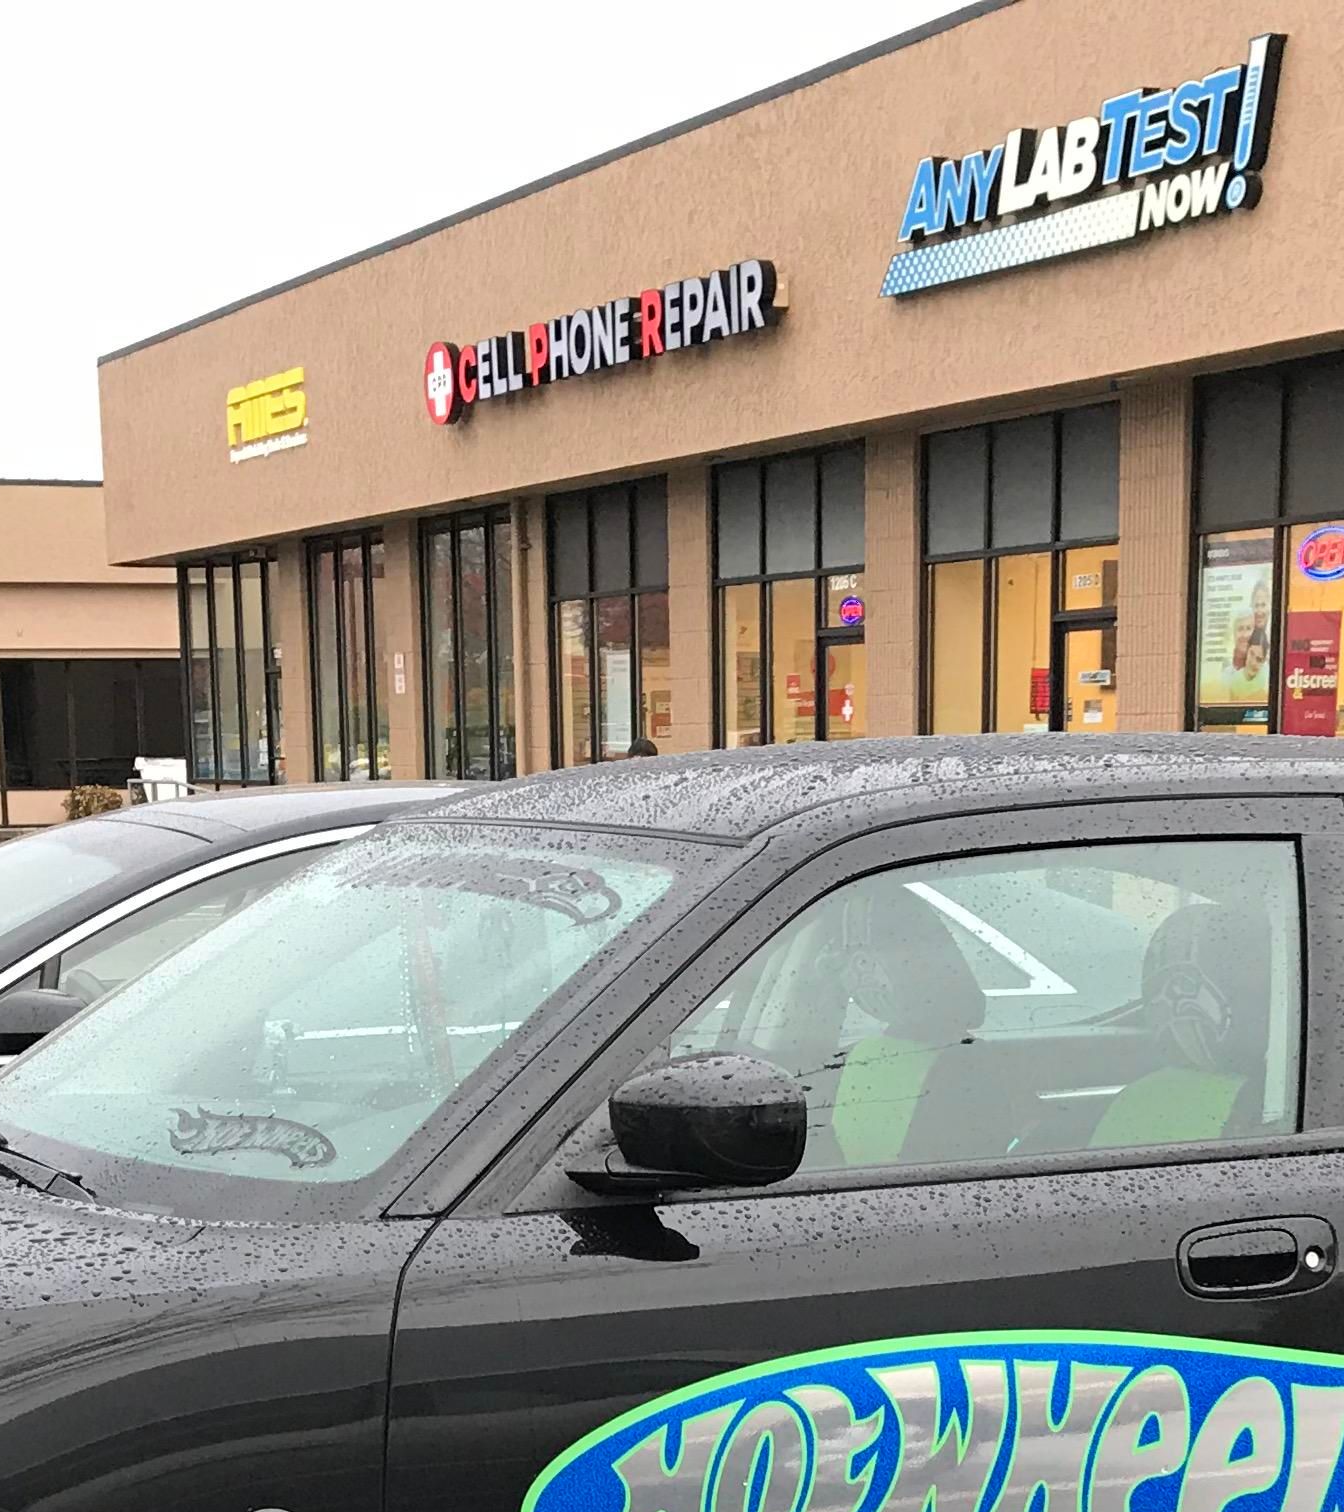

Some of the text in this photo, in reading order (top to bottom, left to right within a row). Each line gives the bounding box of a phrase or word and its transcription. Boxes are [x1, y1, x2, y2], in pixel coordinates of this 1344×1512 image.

[458, 259, 766, 403] CELL PHONE REPAIR
[1286, 668, 1337, 689] discree
